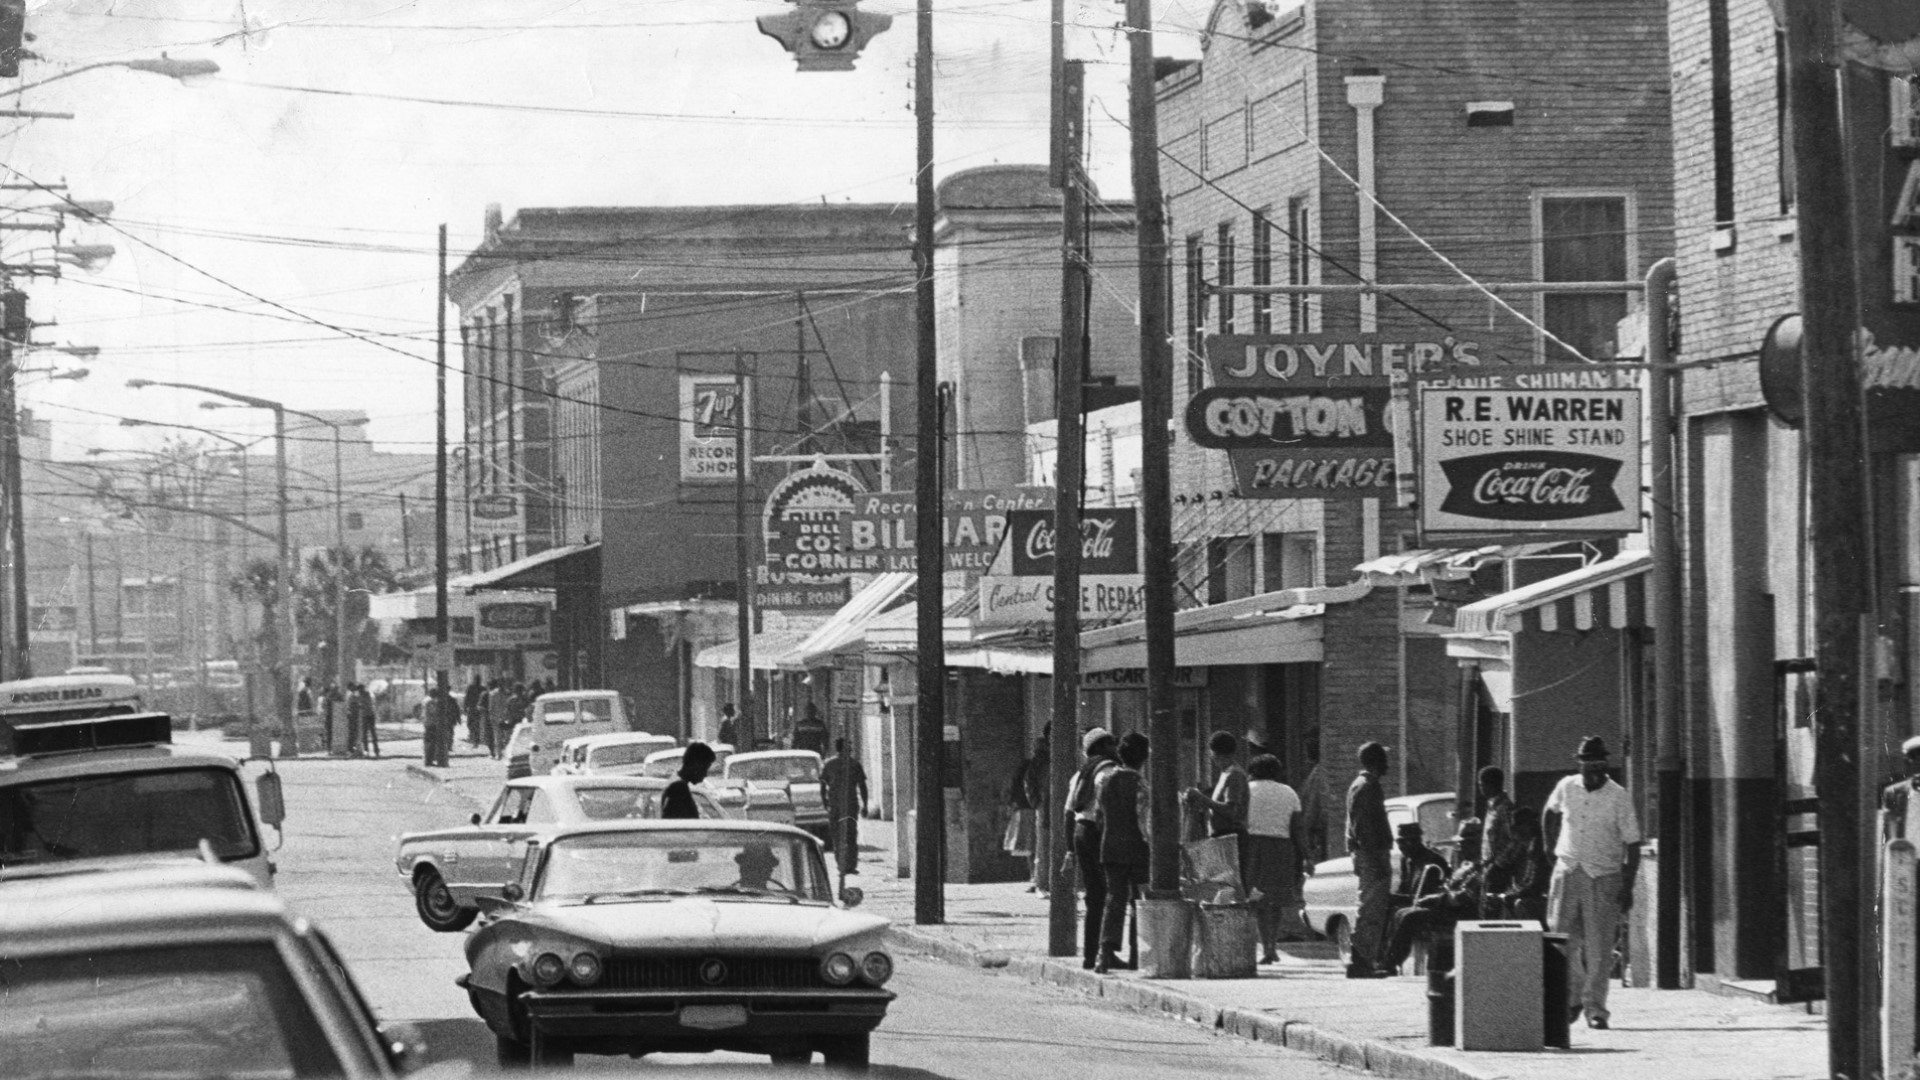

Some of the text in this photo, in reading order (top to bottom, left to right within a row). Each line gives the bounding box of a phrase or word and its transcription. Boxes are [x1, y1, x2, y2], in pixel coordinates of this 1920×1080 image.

[1225, 336, 1480, 378] JOYNER'S
[1205, 396, 1367, 438] COTTON
[1446, 396, 1624, 422] R.E. WARREN
[1442, 428, 1625, 446] SHOE SHINE STAND
[688, 447, 734, 459] RECOR
[1503, 461, 1548, 471] DRINK
[696, 461, 737, 473] SHOP
[1252, 457, 1396, 489] PACKAGE
[1473, 467, 1595, 505] Coca-Cola
[984, 493, 1043, 511] Center
[851, 515, 1007, 551] BILIAR
[1025, 518, 1117, 560] Cocola
[785, 553, 879, 569] CORNER
[890, 552, 993, 570] LAD WELC
[1046, 585, 1090, 612] SE
[1096, 583, 1146, 612] REPAI
